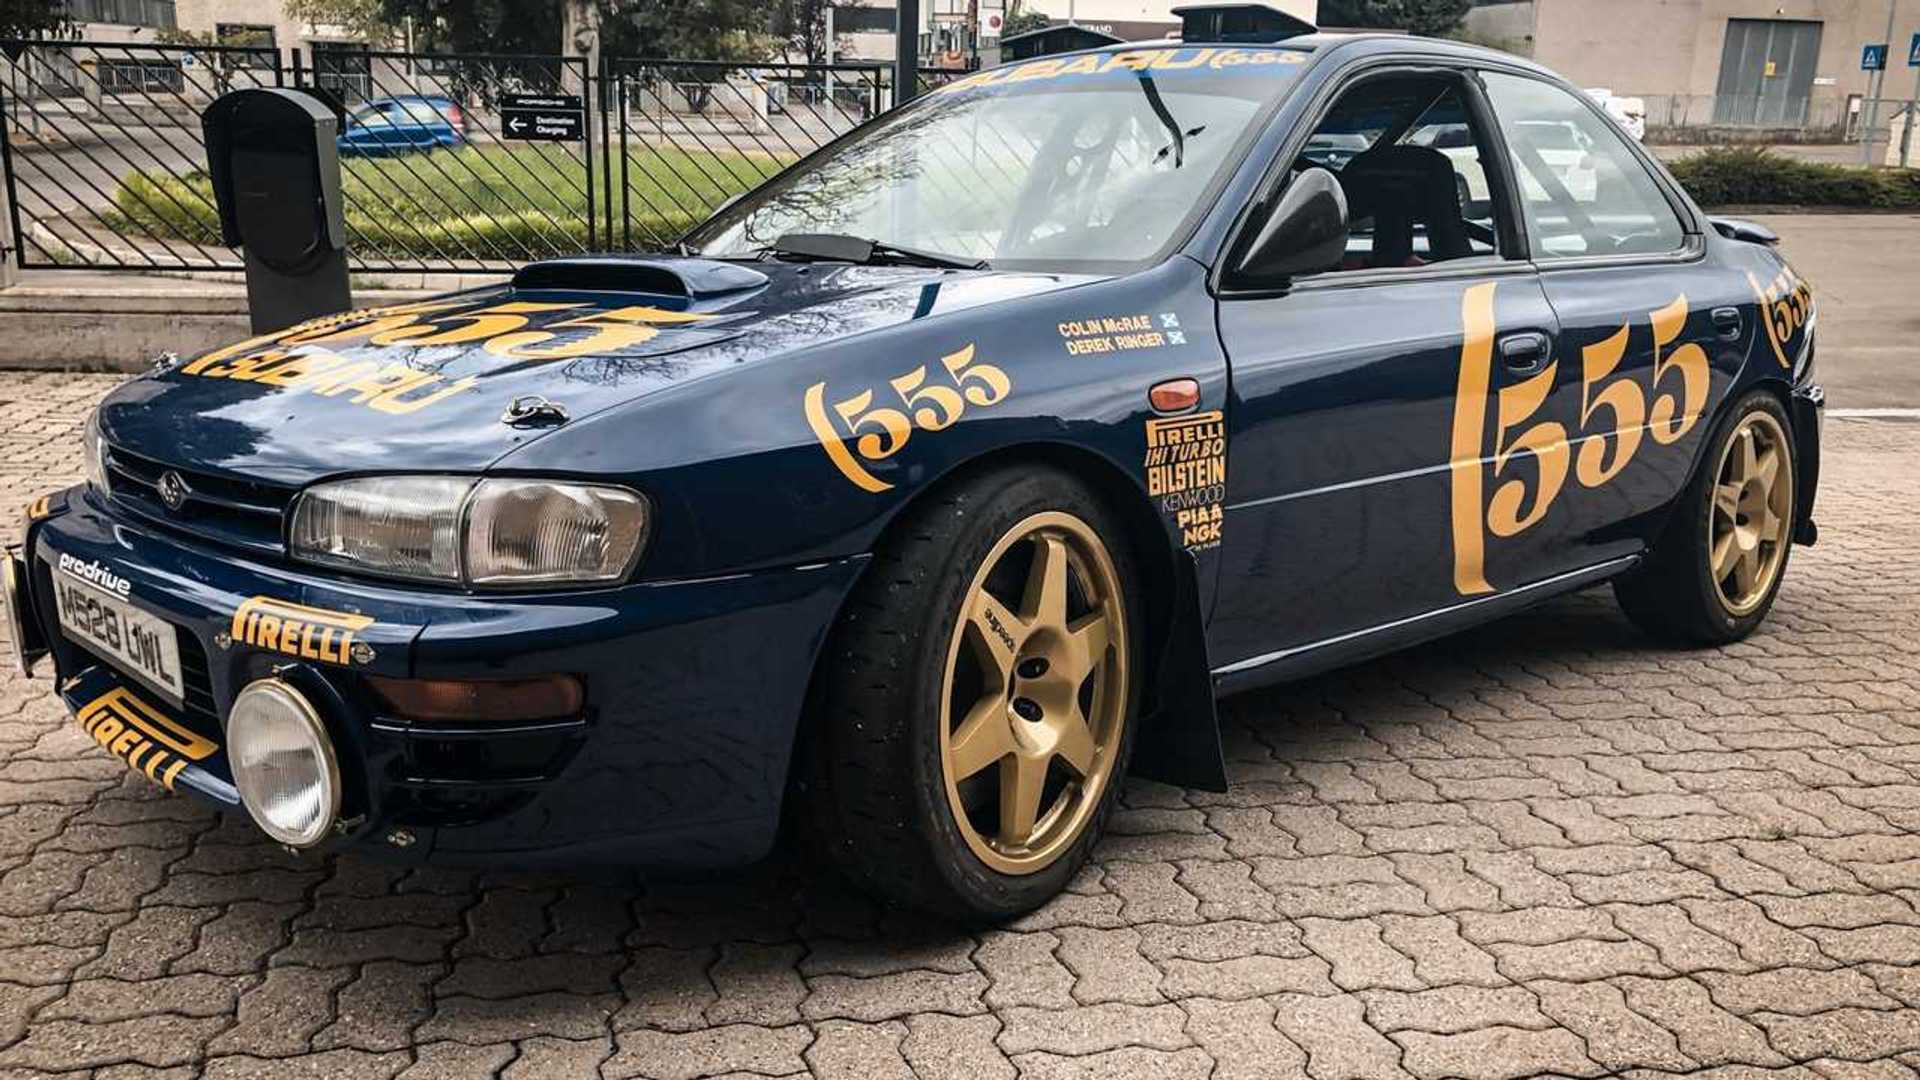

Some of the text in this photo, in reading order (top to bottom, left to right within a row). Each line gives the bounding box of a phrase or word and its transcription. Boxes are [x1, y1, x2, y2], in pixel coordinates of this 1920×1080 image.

[1058, 315, 1152, 337] COLIN McRAE
[1065, 332, 1166, 355] DEREK RINGER
[207, 350, 481, 415] SUBARU
[1145, 409, 1225, 449] PIRELLI
[1169, 438, 1225, 463] TURBO
[1147, 454, 1226, 497] BILSTEIN
[1161, 484, 1226, 513] KENWOOD
[1176, 503, 1224, 529] PIAA
[1183, 520, 1223, 547] NGK
[58, 553, 131, 596] prodrive
[231, 595, 375, 665] PIRELLI
[75, 686, 219, 792] PIRELLI
